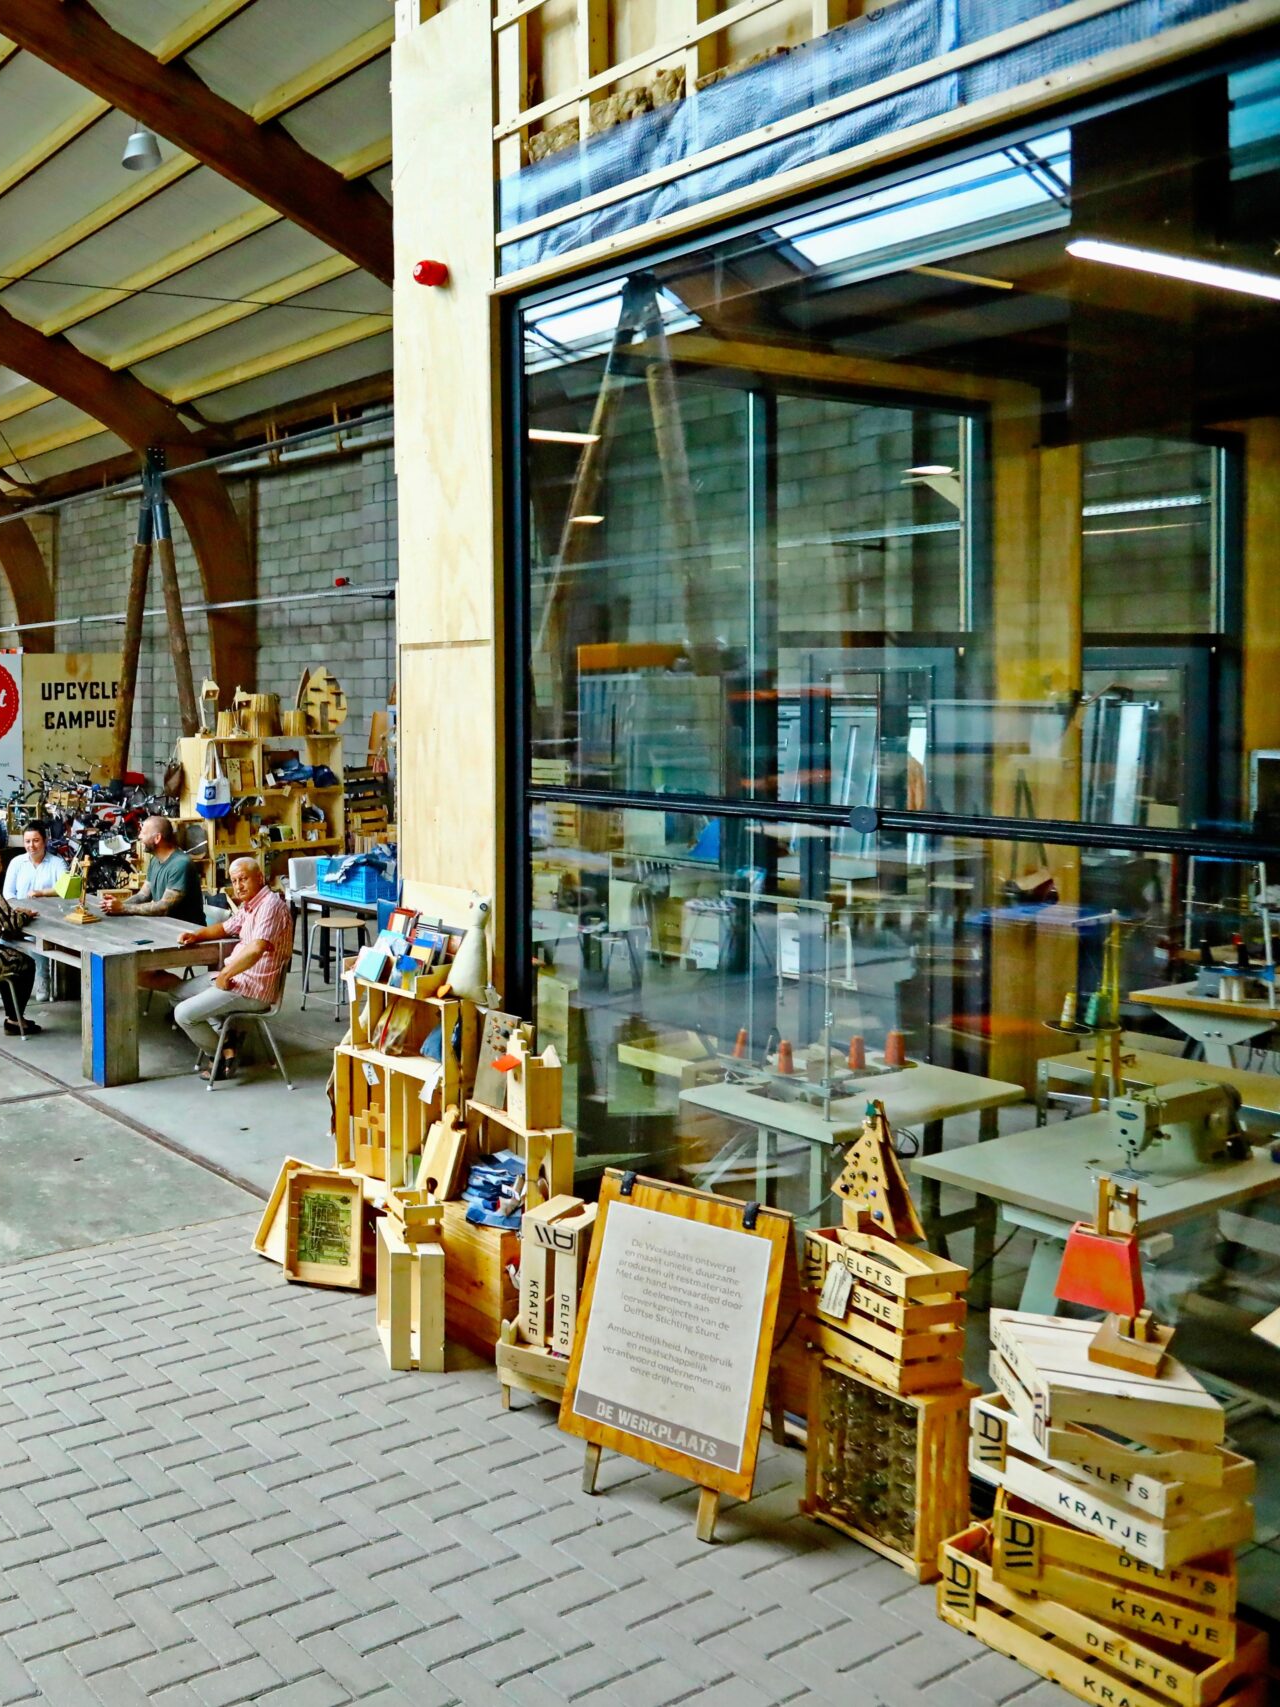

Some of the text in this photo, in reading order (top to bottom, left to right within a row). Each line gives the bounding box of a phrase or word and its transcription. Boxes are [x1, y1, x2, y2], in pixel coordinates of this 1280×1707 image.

[45, 710, 116, 729] CAMPUS
[618, 1260, 661, 1276] producten
[663, 1269, 674, 1280] uit
[631, 1238, 736, 1273] De Werkplaats ontwerpt
[637, 1252, 661, 1264] maakt
[696, 1267, 740, 1285] duurzame
[837, 1253, 892, 1286] DELFTS
[616, 1268, 743, 1310] Met de hand vervaardigd door
[642, 1288, 710, 1312] deelnemers aan
[853, 1291, 891, 1318] STJE
[528, 1280, 539, 1336] KRATJE
[560, 1294, 570, 1345] DELFTS
[623, 1304, 654, 1320] Delftse
[656, 1313, 694, 1333] Stichting
[700, 1318, 717, 1327] van
[718, 1320, 730, 1331] de
[602, 1345, 732, 1393] verantwoord ondernemen zijn
[626, 1341, 708, 1373] en maatschappelijk
[630, 1366, 651, 1378] onze
[684, 1345, 733, 1369] hergebruik
[596, 1401, 718, 1458] DE WERKPLAATS
[1059, 1492, 1148, 1548] KRATJE
[1118, 1555, 1217, 1594] DELFTS
[1111, 1597, 1219, 1643] KRATJE
[1086, 1632, 1178, 1689] DELFTS
